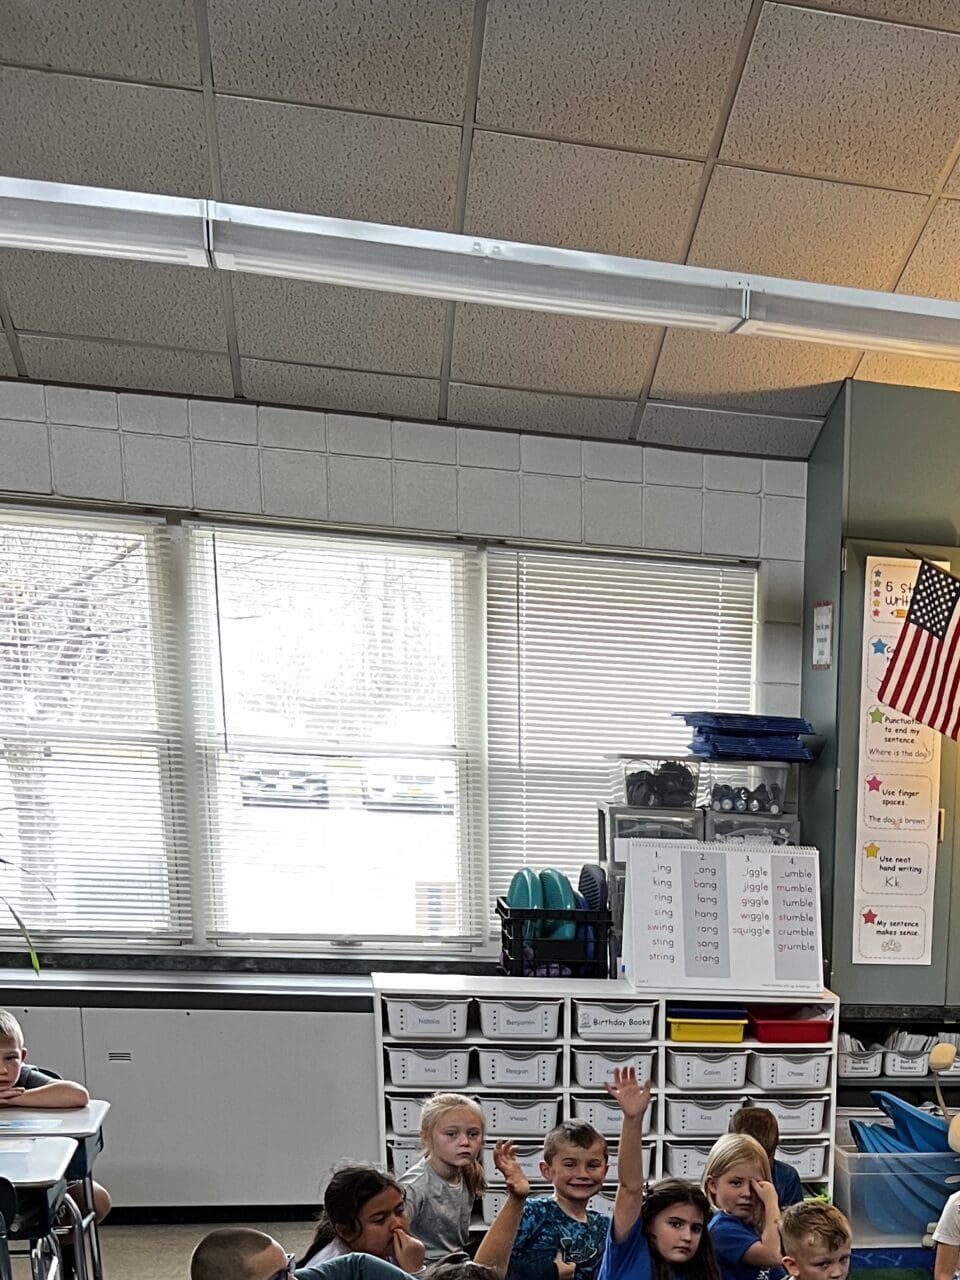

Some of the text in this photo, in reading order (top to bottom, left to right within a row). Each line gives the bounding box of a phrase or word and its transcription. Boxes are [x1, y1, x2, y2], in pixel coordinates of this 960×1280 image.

[885, 595, 911, 606] writ
[910, 728, 920, 736] my
[869, 748, 913, 757] Where is the
[898, 789, 920, 799] finger
[869, 815, 881, 823] The
[883, 816, 896, 825] dog
[898, 865, 922, 874] writing
[652, 878, 673, 889] king
[693, 880, 717, 891] bang
[743, 883, 769, 893] jiggle
[776, 884, 813, 893] mumble
[654, 893, 673, 904] ring
[697, 894, 718, 905] fang
[741, 897, 769, 907] giggle
[782, 898, 813, 908] tumble
[654, 908, 673, 919] sing
[694, 909, 718, 921] hang
[740, 911, 770, 922] wiggle
[778, 913, 814, 922] stumble
[647, 923, 674, 934] swing
[876, 920, 887, 928] My
[697, 925, 719, 936] rang
[732, 926, 770, 937] squiggle
[778, 927, 815, 936] crumble
[652, 938, 674, 949] sting
[697, 939, 719, 950] sang
[777, 942, 815, 953] grumble
[648, 952, 675, 963] string
[694, 953, 720, 965] clang
[593, 1018, 651, 1027] Birthday Books
